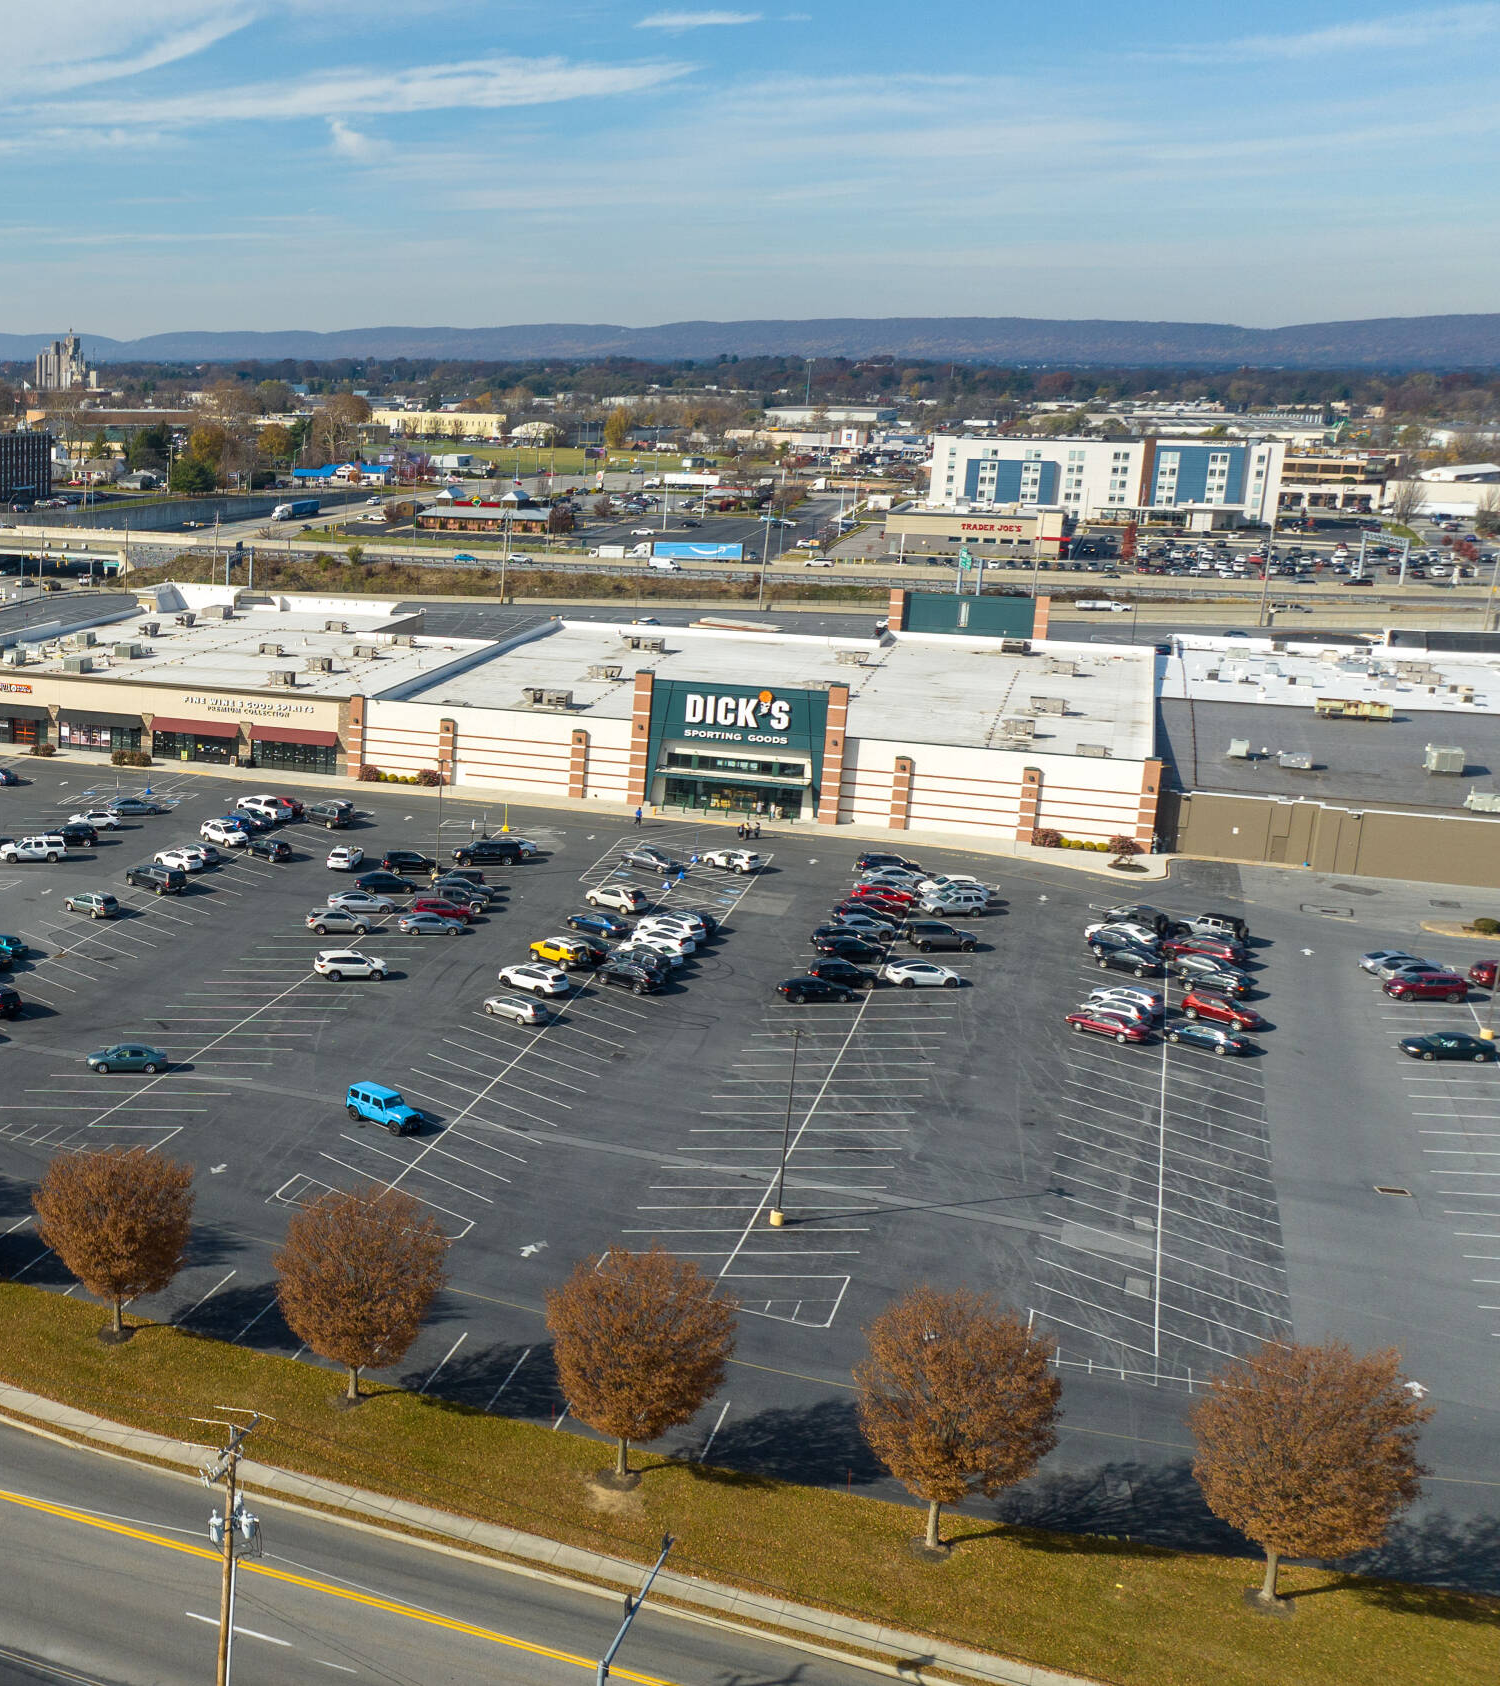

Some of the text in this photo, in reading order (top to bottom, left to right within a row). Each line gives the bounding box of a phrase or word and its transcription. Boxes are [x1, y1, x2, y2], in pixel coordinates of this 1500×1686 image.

[961, 523, 1023, 532] TRADER JOE'S
[182, 696, 206, 705] FINE
[209, 698, 235, 707] WINE
[246, 702, 274, 710] GOOD
[276, 703, 315, 713] SPIRITS
[207, 705, 291, 718] PREMIUM COLLECTION
[685, 690, 791, 730] DICK'S
[684, 729, 789, 745] SPORTING GOODS
